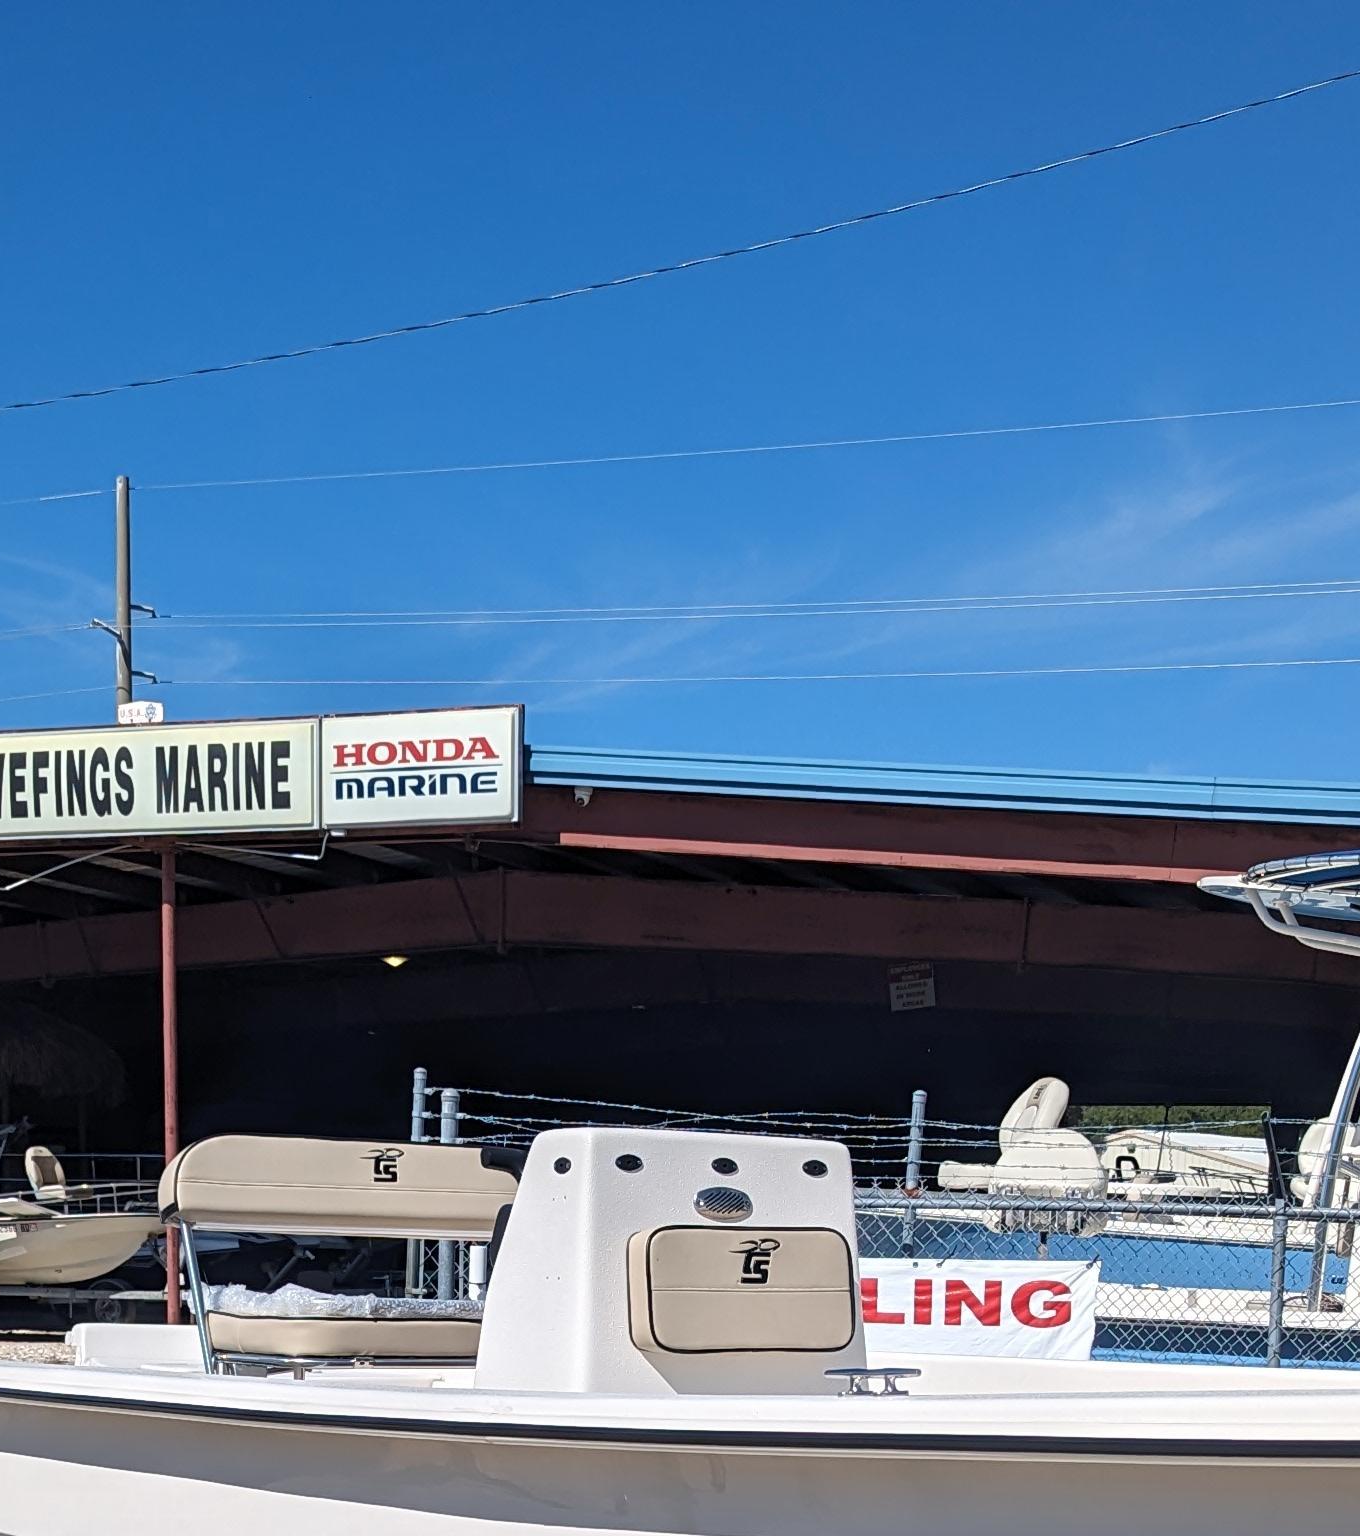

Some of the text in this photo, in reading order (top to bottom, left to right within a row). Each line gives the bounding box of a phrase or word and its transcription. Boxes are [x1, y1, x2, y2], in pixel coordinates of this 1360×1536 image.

[332, 737, 500, 767] HONDA
[155, 740, 292, 814] MARINE
[335, 771, 498, 800] MARINE
